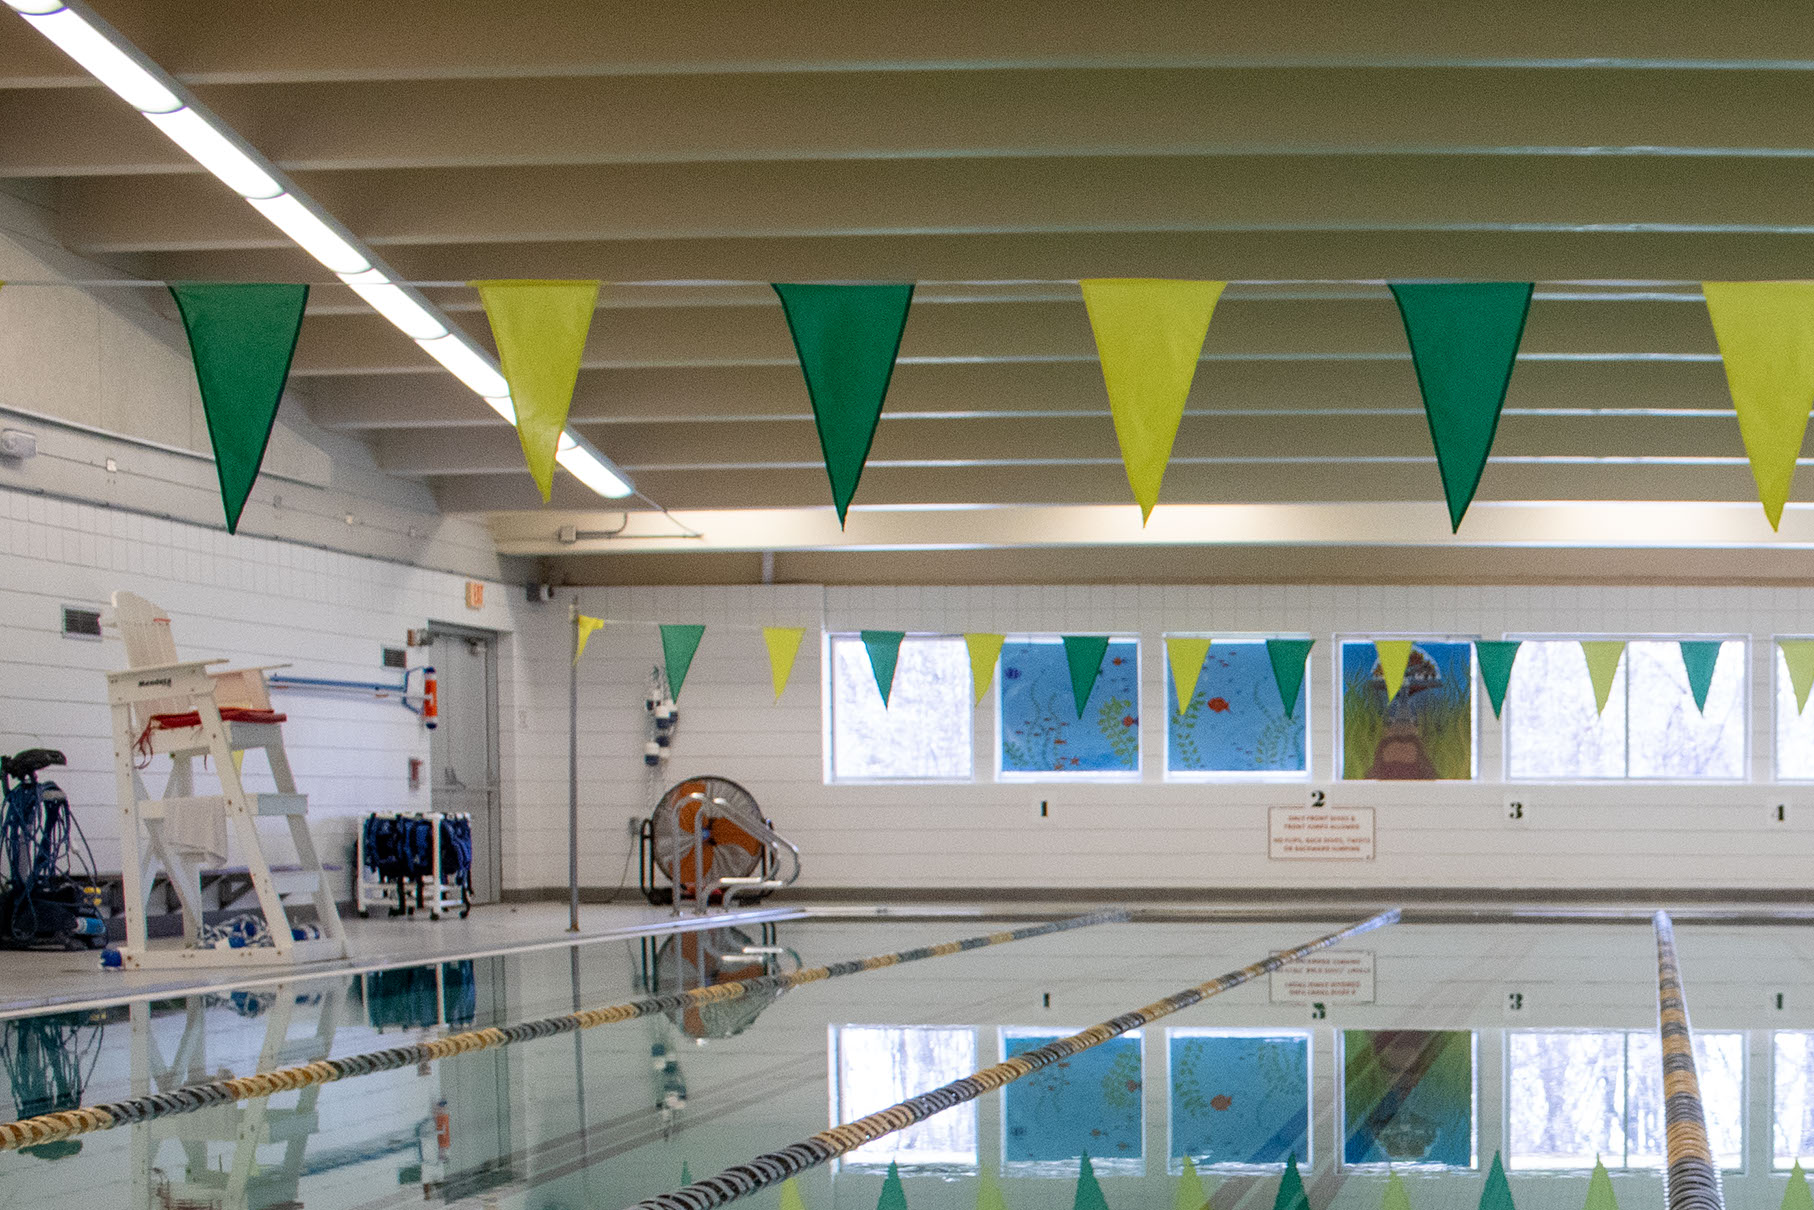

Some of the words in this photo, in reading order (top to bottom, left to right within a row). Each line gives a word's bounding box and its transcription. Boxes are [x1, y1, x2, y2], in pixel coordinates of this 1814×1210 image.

[1311, 790, 1325, 808] 2
[1041, 801, 1048, 817] 1
[1508, 801, 1524, 819] 3
